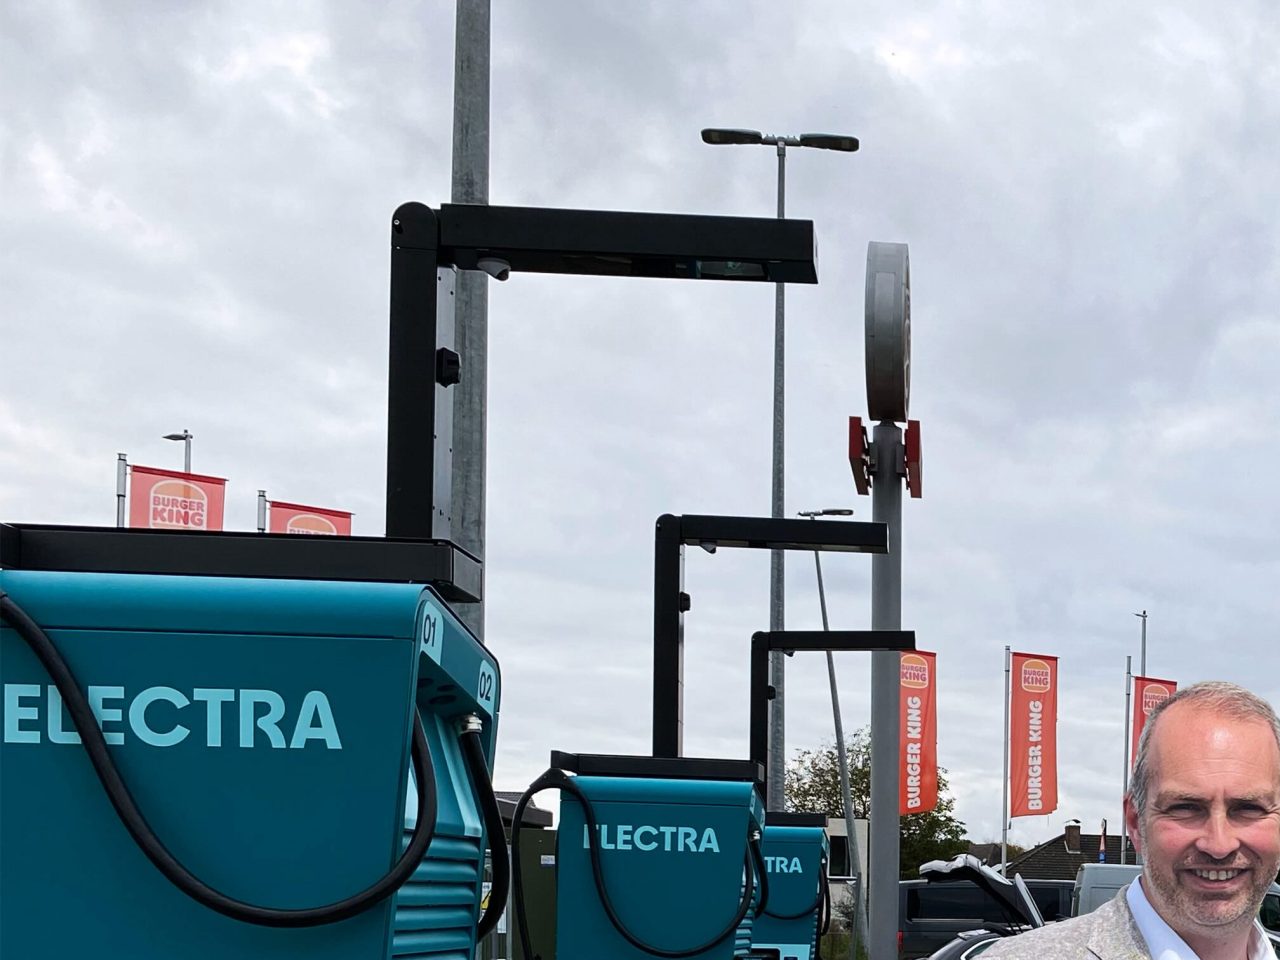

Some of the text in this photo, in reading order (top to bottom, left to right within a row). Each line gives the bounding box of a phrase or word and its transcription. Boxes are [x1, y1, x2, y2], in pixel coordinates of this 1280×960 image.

[152, 495, 205, 513] BURGER
[152, 507, 204, 527] KING
[423, 614, 437, 647] 01
[901, 664, 927, 673] BURGER
[901, 671, 927, 682] KING
[1023, 669, 1049, 678] BURGER
[479, 671, 492, 702] 02
[1023, 676, 1049, 686] KING
[4, 684, 342, 749] ELECTRA
[907, 696, 921, 809] BURGER KING
[1028, 700, 1043, 810] BURGER KING
